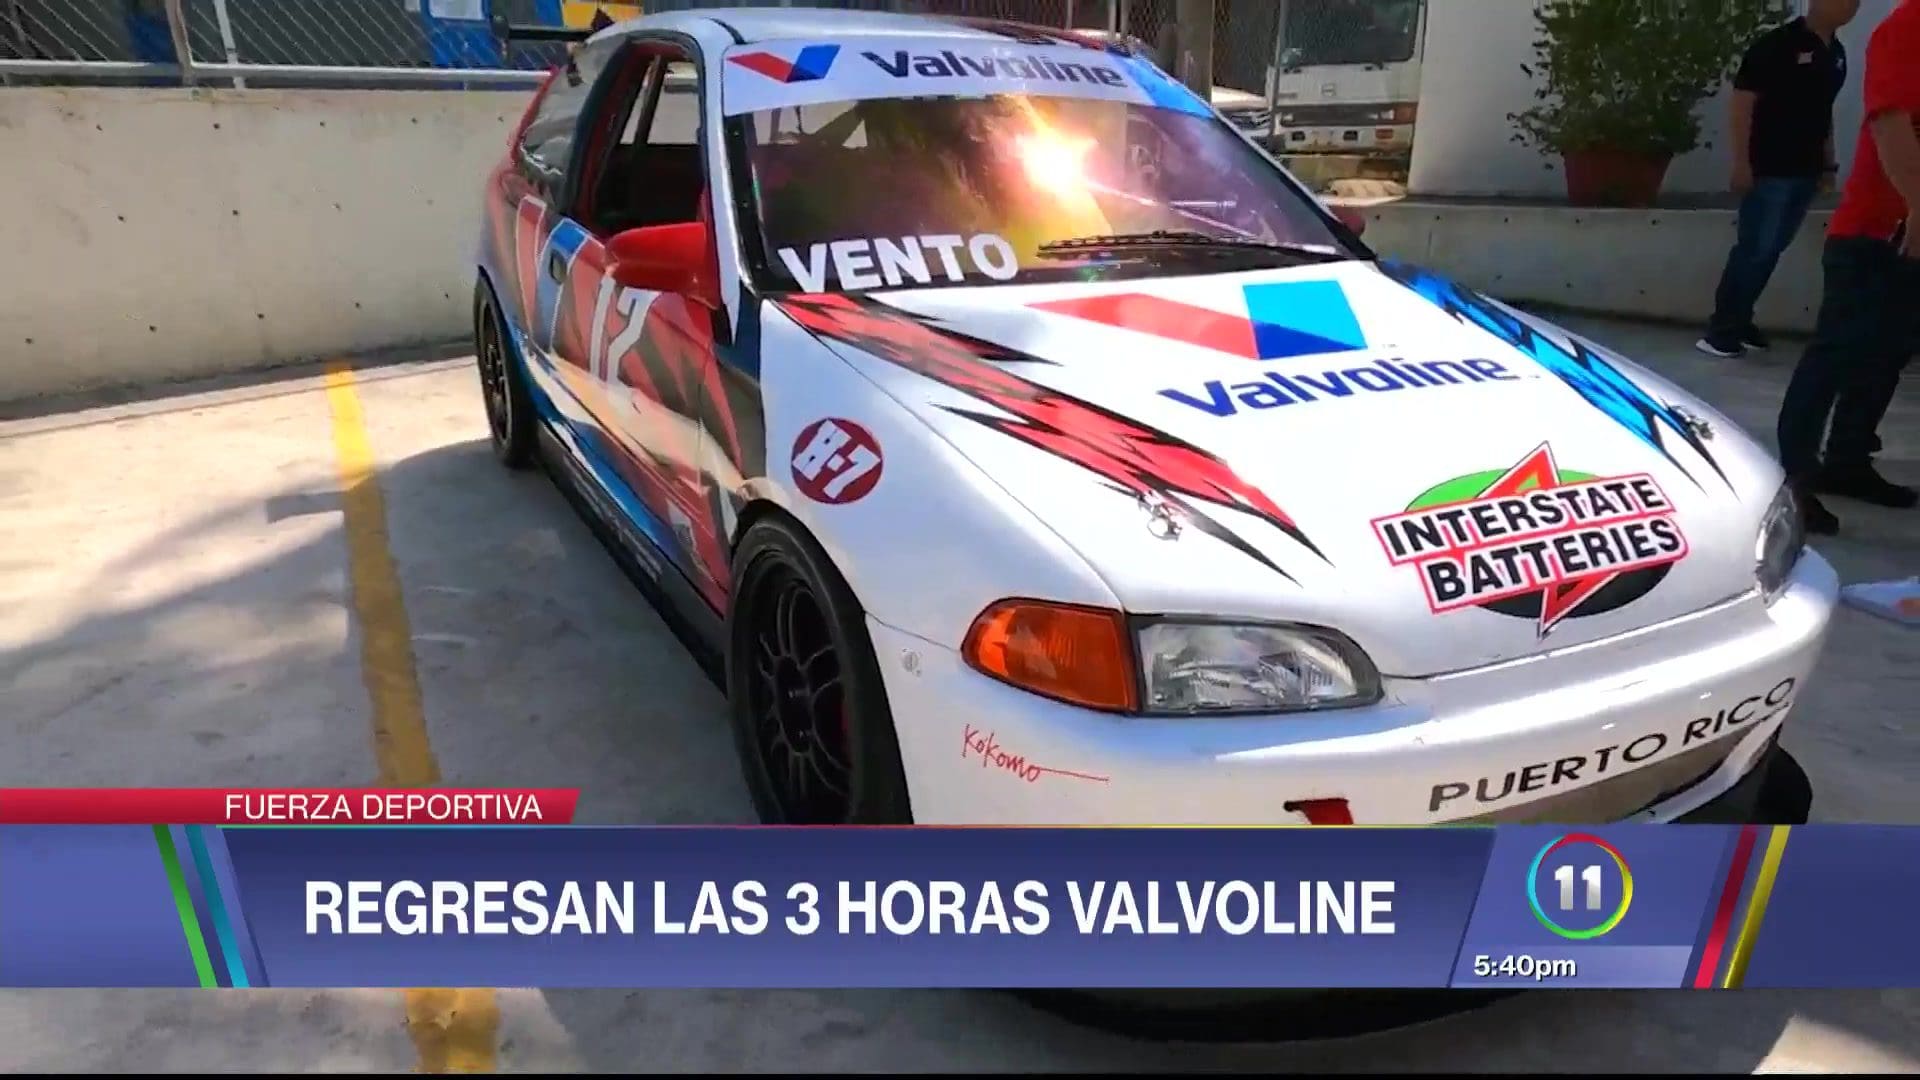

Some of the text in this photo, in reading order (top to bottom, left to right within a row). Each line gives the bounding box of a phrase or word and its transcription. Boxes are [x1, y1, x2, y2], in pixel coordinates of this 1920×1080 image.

[861, 49, 1128, 88] Valvoline
[778, 233, 1019, 293] VENTO
[1157, 357, 1521, 417] Valvoline
[1383, 479, 1664, 556] INTERSTATE
[1427, 518, 1679, 603] BATTERIES
[1428, 677, 1796, 812] PUERTO RICO
